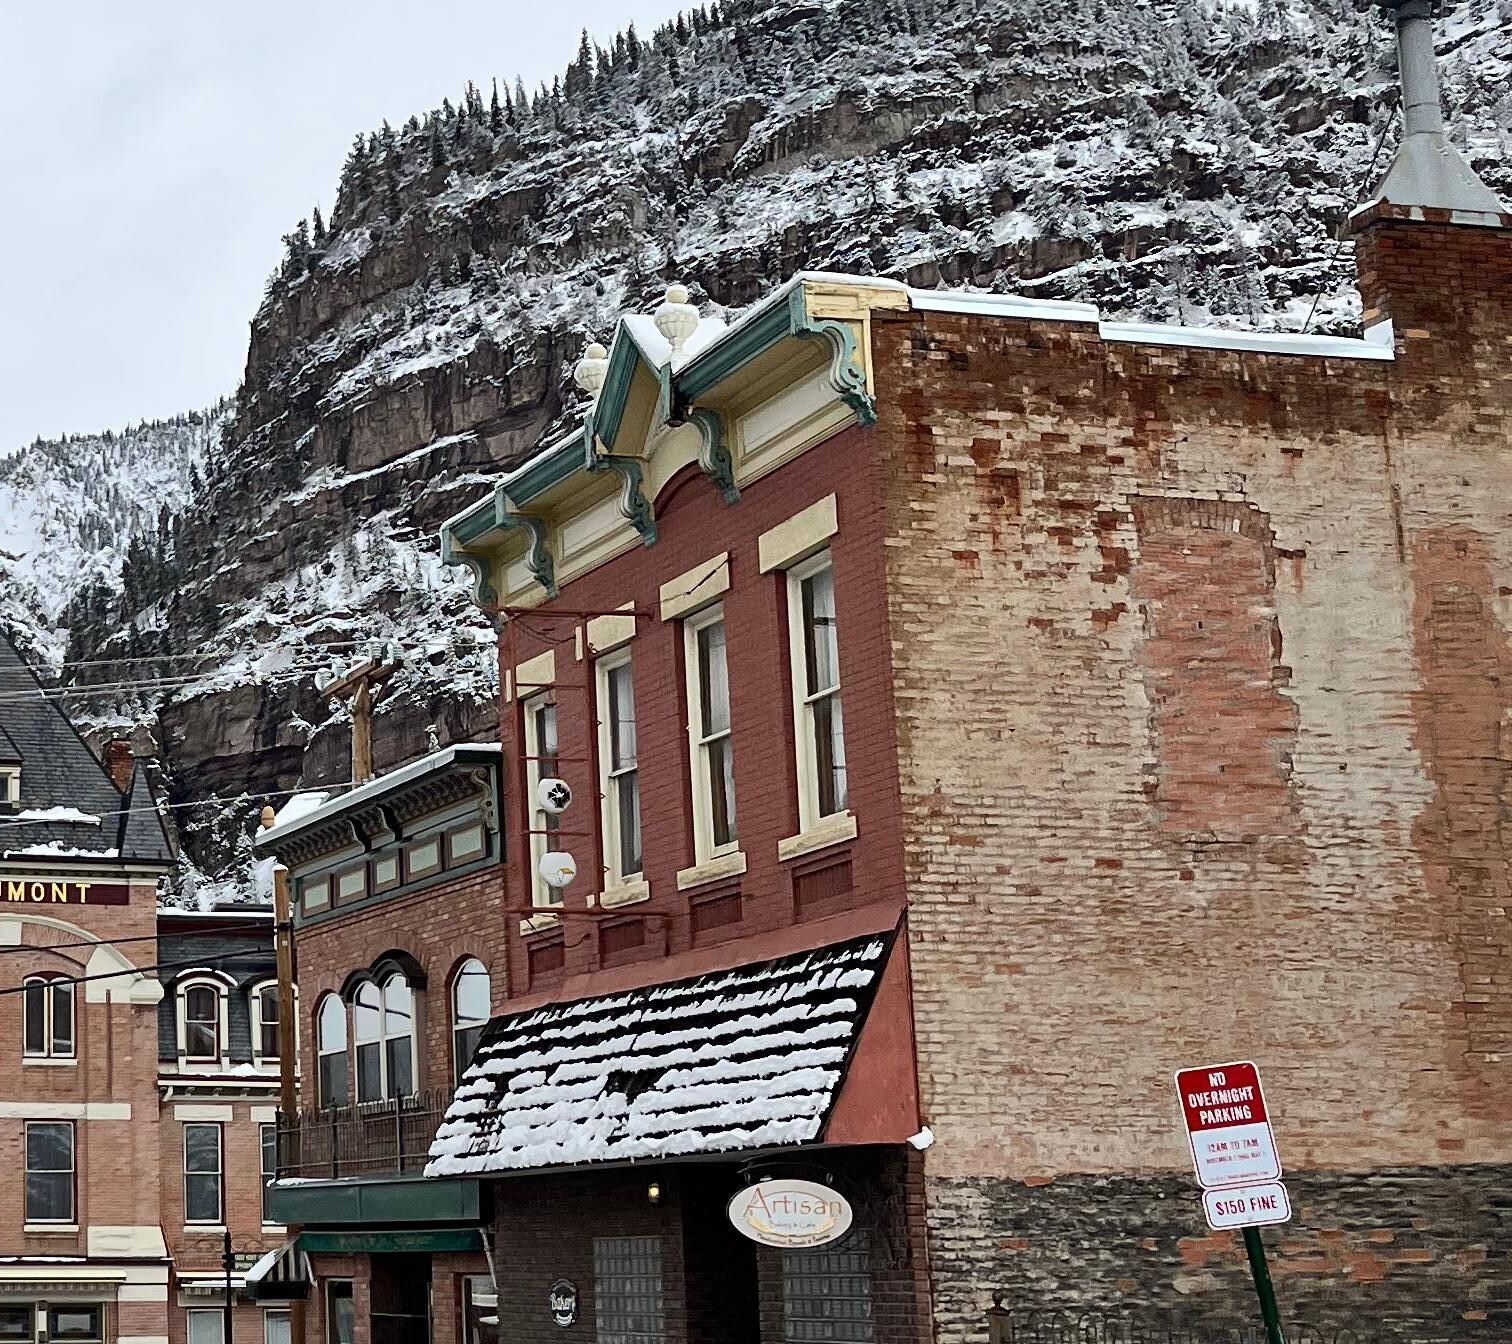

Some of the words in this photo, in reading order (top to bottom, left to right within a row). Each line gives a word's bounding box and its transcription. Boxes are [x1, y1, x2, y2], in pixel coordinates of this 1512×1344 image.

[1208, 1071, 1226, 1087] NO
[1188, 1086, 1254, 1108] OVERNIGHT
[1199, 1105, 1253, 1125] PARKING
[743, 1187, 842, 1219] Artisan
[1215, 1199, 1246, 1216] $150
[1250, 1195, 1278, 1212] FINE
